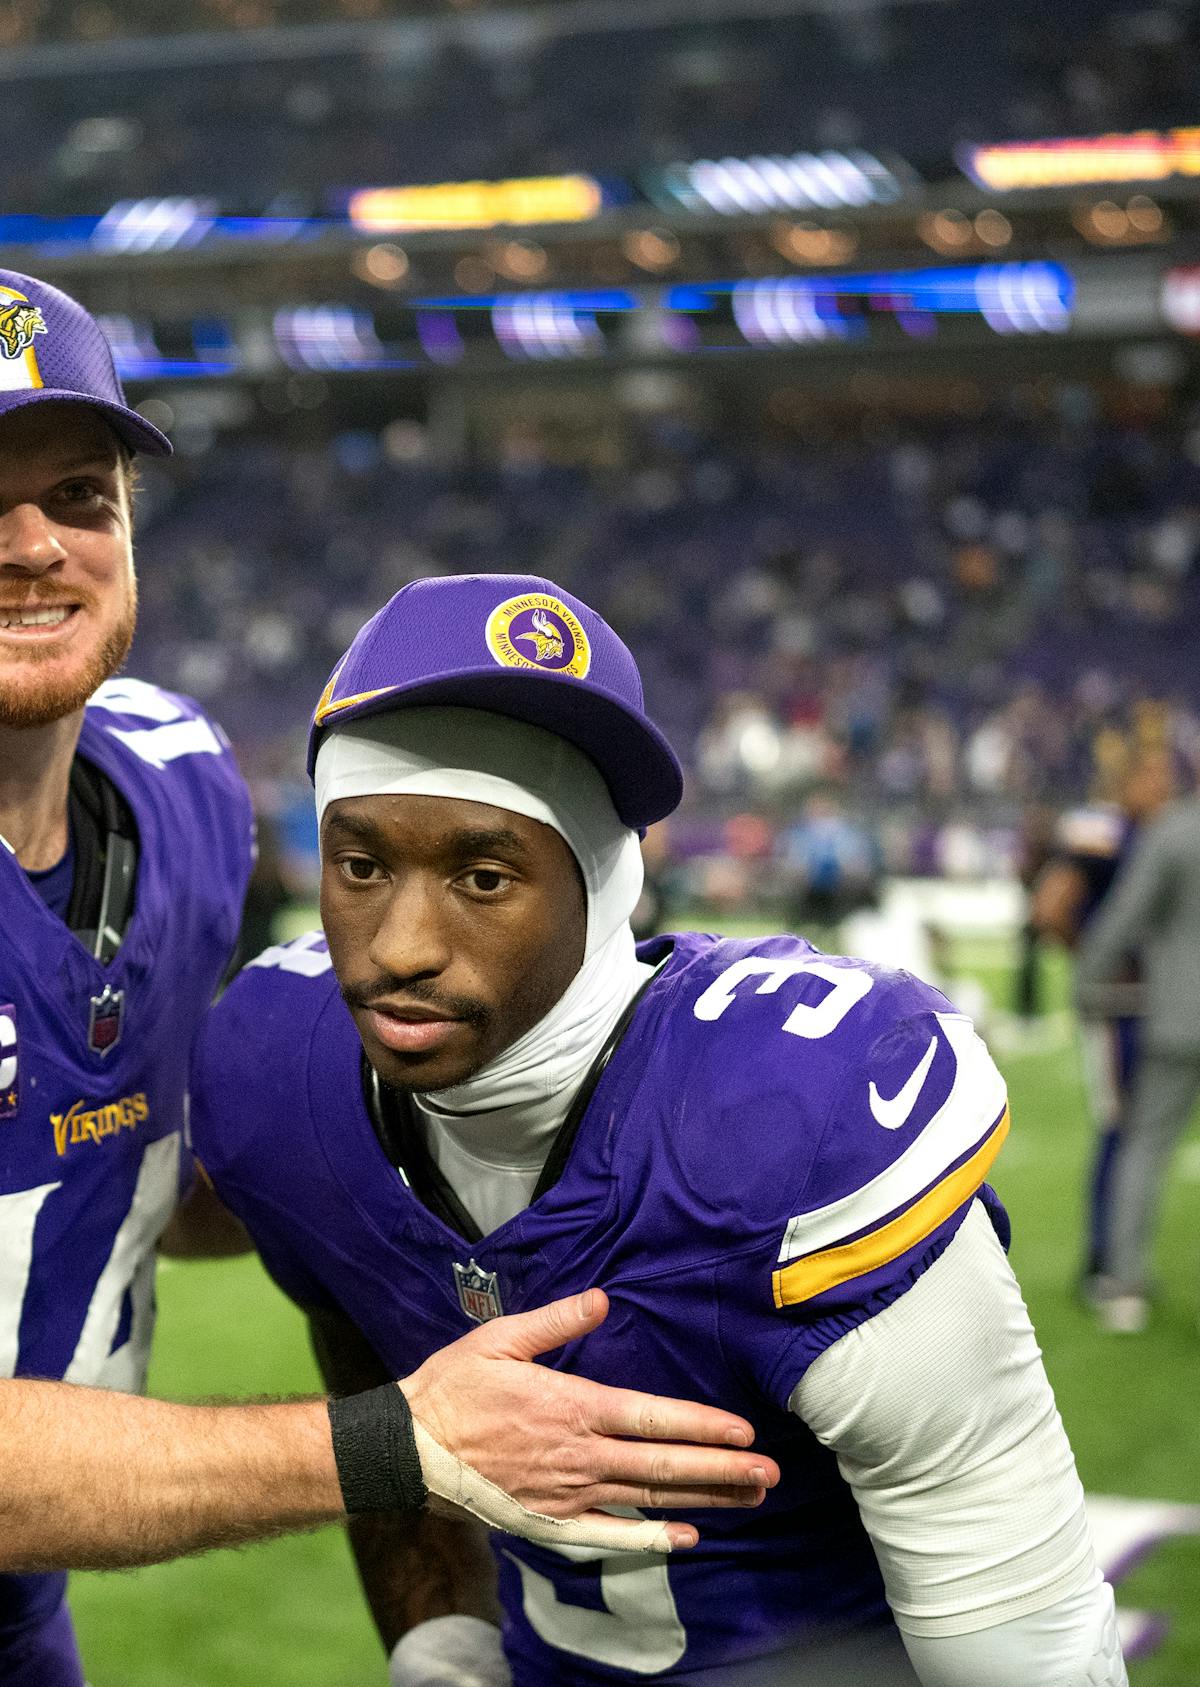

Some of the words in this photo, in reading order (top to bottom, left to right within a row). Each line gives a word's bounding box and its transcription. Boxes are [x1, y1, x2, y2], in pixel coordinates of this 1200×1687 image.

[503, 598, 560, 617] MINNESOTA
[562, 611, 585, 652] VIKINGS
[495, 632, 538, 669] MINNESO
[693, 956, 874, 1040] 3
[465, 1292, 498, 1318] NFL
